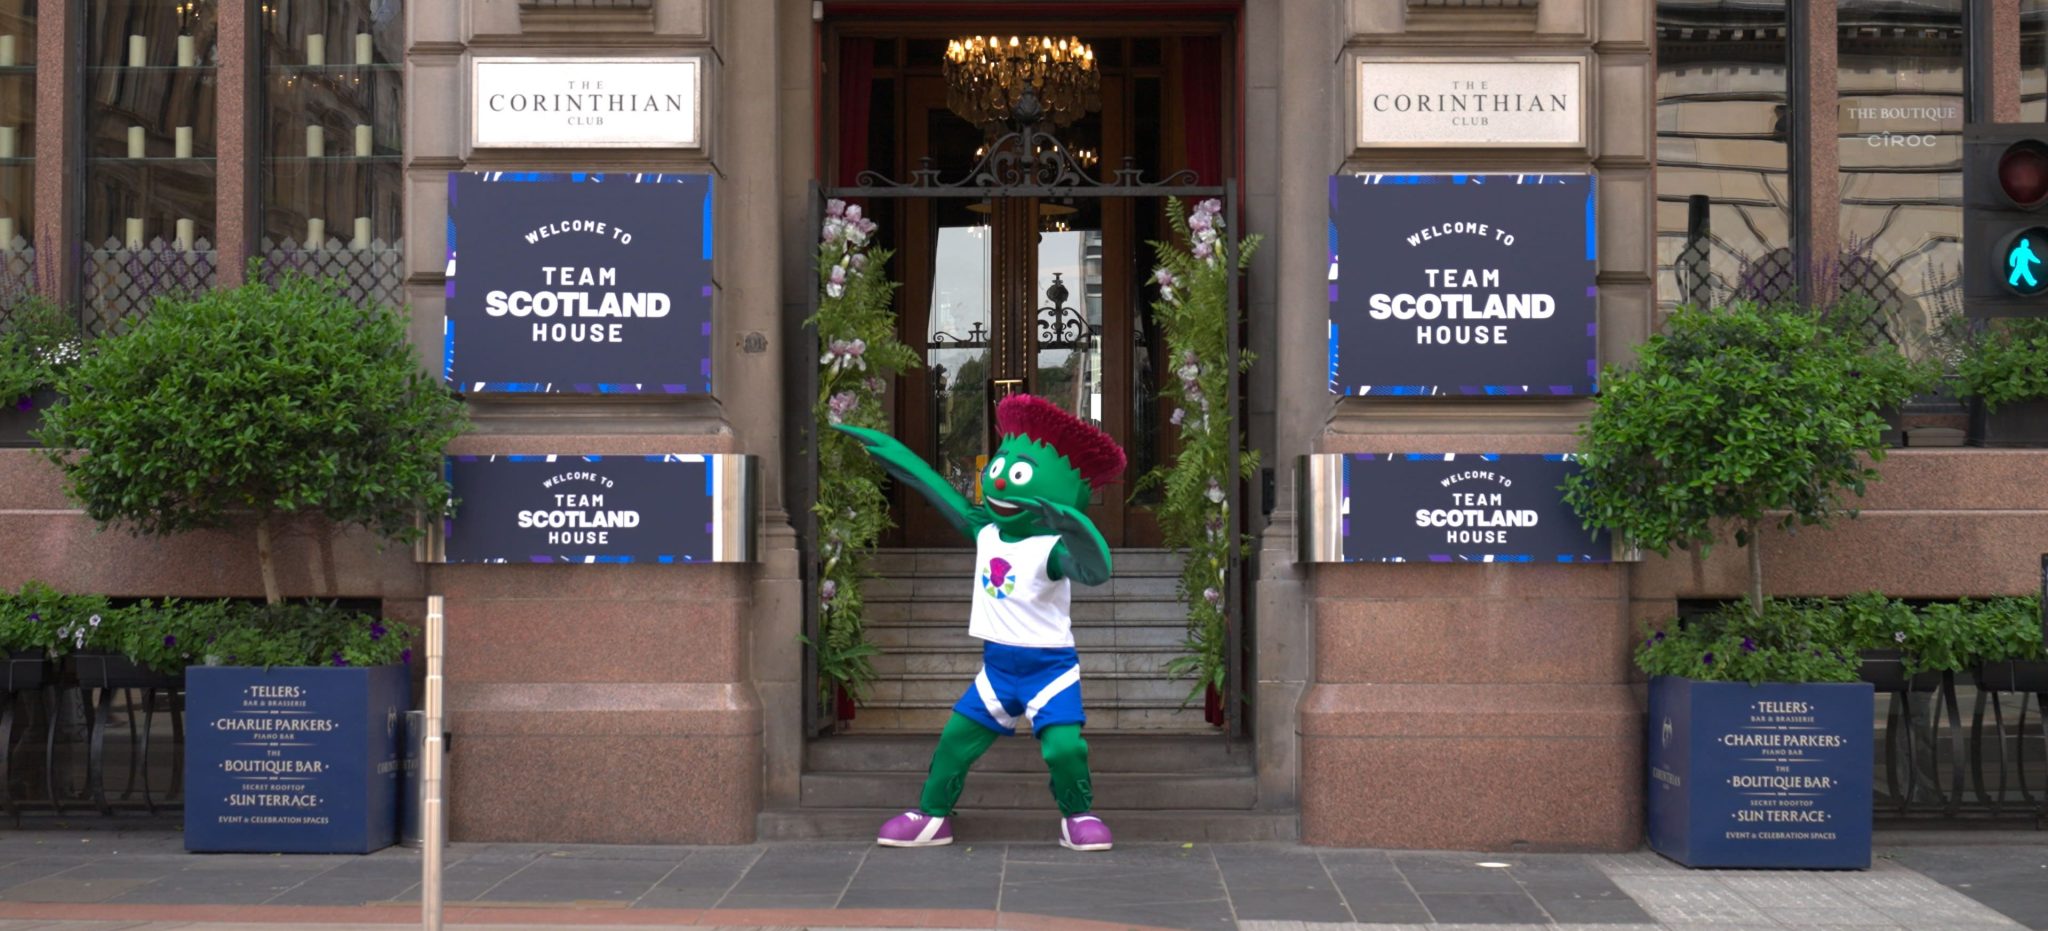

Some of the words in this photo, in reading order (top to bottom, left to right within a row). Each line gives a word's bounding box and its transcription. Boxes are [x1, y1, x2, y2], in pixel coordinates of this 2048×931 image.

[568, 81, 604, 90] THE
[1453, 81, 1489, 90] THE
[489, 94, 682, 112] CORINTHIAN
[1373, 94, 1567, 112] CORINTHIAN
[1848, 107, 1877, 119] THE
[1880, 107, 1956, 121] BOUTIQUE
[567, 117, 604, 126] CLUB
[1452, 117, 1489, 126] CLUB
[525, 220, 607, 244] WELCOME
[613, 227, 632, 245] TO
[1407, 222, 1489, 247] WELCOME
[1495, 229, 1515, 246] TO
[542, 267, 616, 286] TEAM
[1425, 269, 1500, 288] TEAM
[485, 290, 671, 318] SCOTLAND
[1369, 293, 1556, 320] SCOTLAND
[532, 323, 623, 343] HOUSE
[1417, 325, 1508, 345] HOUSE
[542, 472, 597, 488] WELCOME
[601, 476, 614, 488] TO
[1441, 470, 1495, 487] WELCOME
[1498, 475, 1512, 487] TO
[554, 494, 604, 507] TEAM
[1452, 493, 1502, 506] TEAM
[518, 510, 640, 528] SCOTLAND
[1416, 509, 1539, 527] SCOTLAND
[548, 531, 609, 544] HOUSE
[1447, 530, 1508, 543] HOUSE
[250, 686, 300, 698] TELLERS
[1757, 701, 1808, 713] TELLERS
[217, 718, 272, 731] CHARLIE
[275, 719, 333, 731] PARKERS
[1724, 734, 1781, 747] CHARLIE
[1783, 735, 1841, 747] PARKERS
[225, 760, 293, 774] BOUTIQUE
[295, 760, 323, 773] BAR
[1732, 776, 1801, 790] BOUTIQUE
[1804, 776, 1831, 788] BAR
[229, 794, 256, 807] SUN
[258, 795, 317, 807] TERRACE
[250, 816, 302, 824] CELEBRATION
[1737, 810, 1764, 822] SUN
[1766, 810, 1825, 823] TERRACE
[1758, 832, 1810, 840] CELEBRATION
[1811, 832, 1837, 840] SPACES
